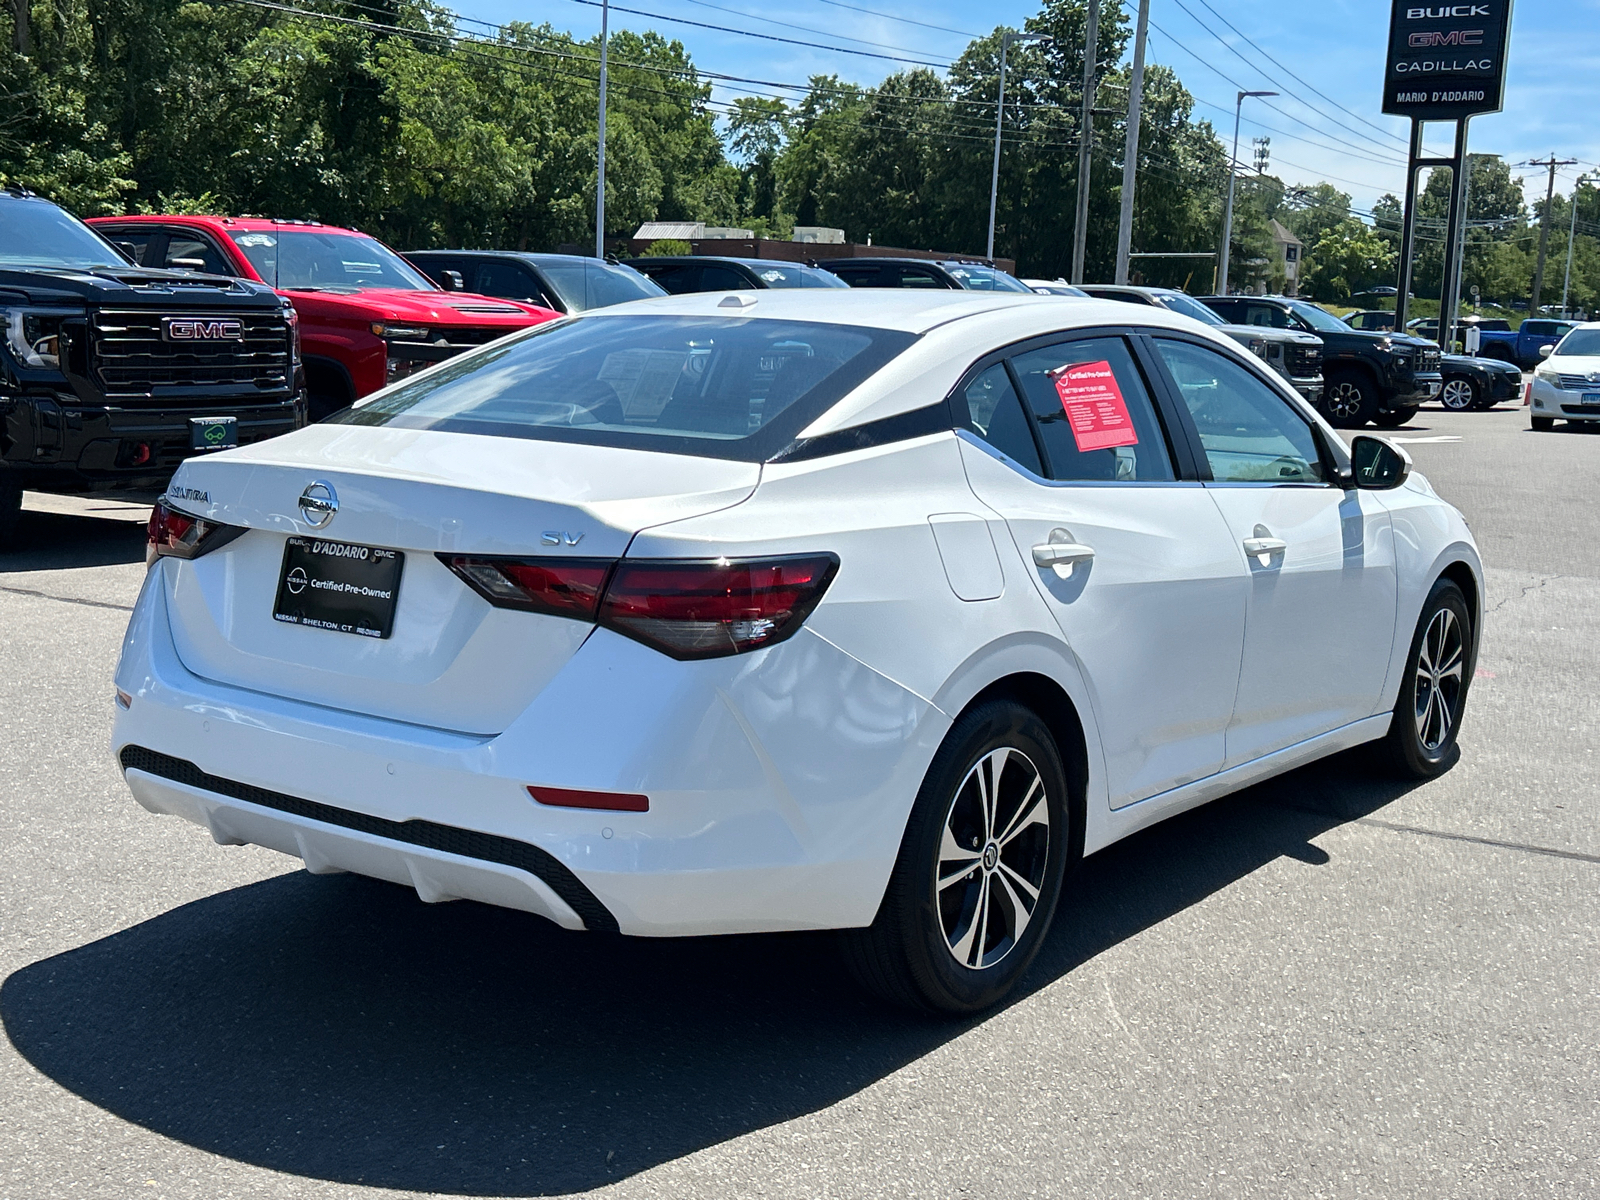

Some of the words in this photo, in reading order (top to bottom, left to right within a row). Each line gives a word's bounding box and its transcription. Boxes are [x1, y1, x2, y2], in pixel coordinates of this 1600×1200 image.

[1406, 4, 1491, 19] BUICK
[1408, 29, 1484, 48] GMC
[1395, 59, 1492, 73] CADILLAC
[1396, 92, 1428, 103] MARIO
[1431, 90, 1485, 102] D'ADDARIO
[169, 321, 241, 339] GMC
[541, 531, 586, 547] SV
[312, 541, 369, 560] D'ADDARIO
[374, 549, 396, 559] GMC
[287, 576, 308, 585] NISSAN
[311, 579, 344, 592] Certified
[344, 584, 391, 600] Pre-Owned
[275, 613, 298, 623] NISSAN
[341, 624, 353, 632] CT
